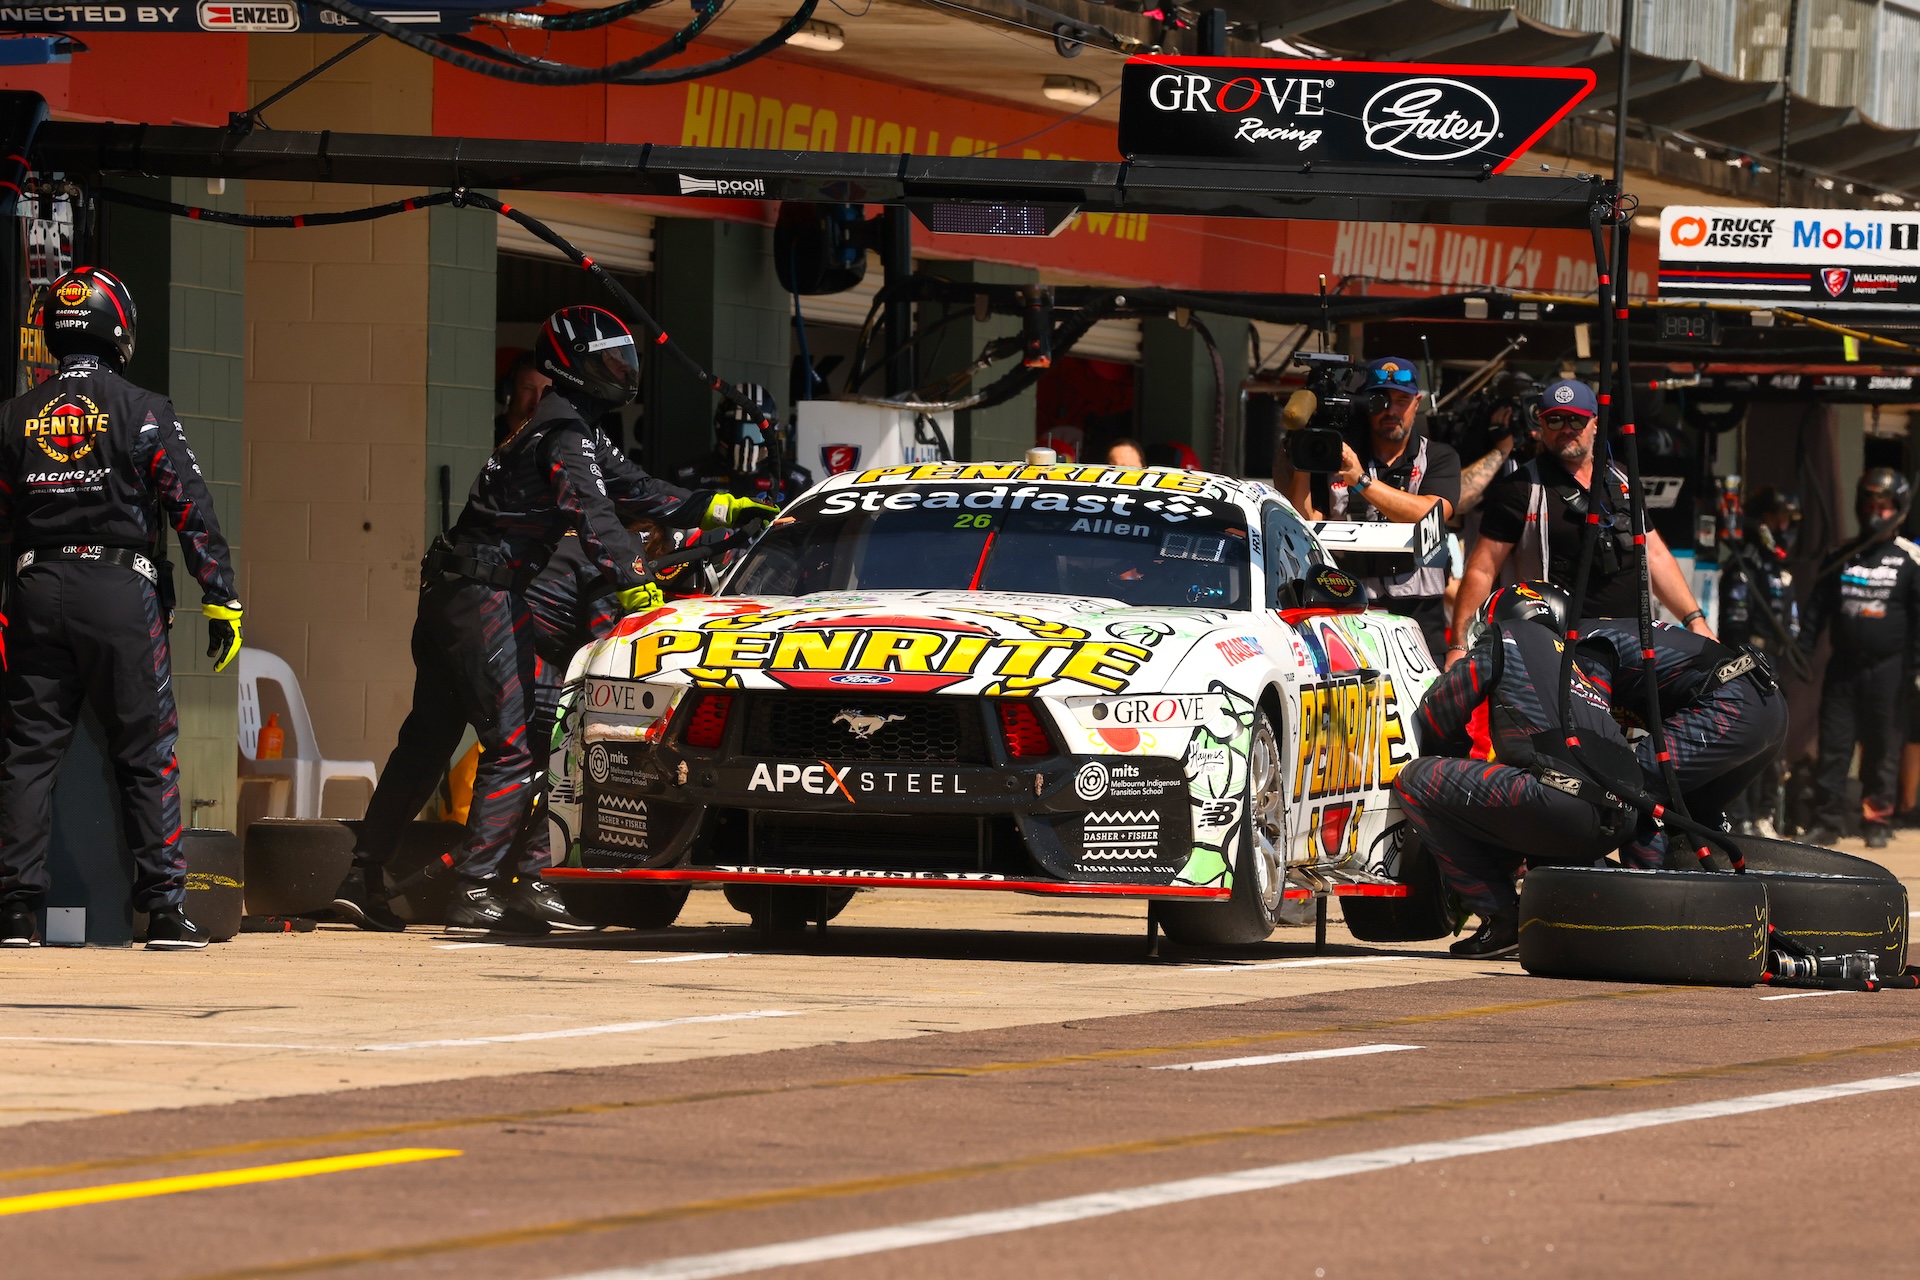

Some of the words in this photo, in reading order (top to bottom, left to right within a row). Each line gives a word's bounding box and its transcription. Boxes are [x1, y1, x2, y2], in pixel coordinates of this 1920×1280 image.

[137, 6, 180, 23] BY
[233, 7, 289, 24] ENZED
[1149, 73, 1325, 116] GROVE
[1380, 88, 1489, 143] Gates
[1234, 117, 1323, 151] Racing
[716, 178, 765, 195] paoli
[1711, 217, 1775, 233] TRUCK
[1704, 234, 1772, 248] ASSIST
[1793, 220, 1882, 250] Mobil
[1894, 224, 1915, 249] 1
[1332, 220, 1437, 291] HIDDEN
[1440, 230, 1542, 295] VALLEY
[1853, 273, 1918, 284] WALKINSHAW
[56, 287, 93, 297] PENRITE
[55, 320, 89, 330] SHIPPY
[24, 413, 110, 437] PENRITE
[26, 470, 85, 483] RACING
[851, 463, 1212, 494] PENRITE
[819, 486, 1136, 516] Steadfast
[953, 513, 992, 529] 26
[1069, 517, 1151, 538] Allen
[62, 546, 103, 554] GROVE
[1316, 577, 1358, 588] PENRITE
[630, 629, 1153, 695] PENRITE
[1114, 698, 1204, 724] GROVE
[1293, 674, 1412, 803] PENRITE
[610, 750, 629, 765] mits
[610, 765, 634, 776] Melbourne
[634, 769, 660, 781] Indigenous
[1111, 763, 1140, 778] mits
[610, 774, 630, 784] Transition
[631, 777, 648, 787] School
[747, 760, 856, 804] APEX
[860, 772, 967, 794] STEEL
[1111, 780, 1145, 788] Melbourne
[1146, 779, 1181, 789] Indigenous
[1111, 788, 1141, 796] Transition
[1142, 787, 1163, 795] School
[598, 813, 621, 827] DASHER
[625, 816, 648, 830] FISHER
[1083, 832, 1119, 841] DASHER
[1128, 831, 1158, 840] FISHER
[1074, 863, 1151, 873] TASMANIAN
[1154, 866, 1177, 874] GIN
